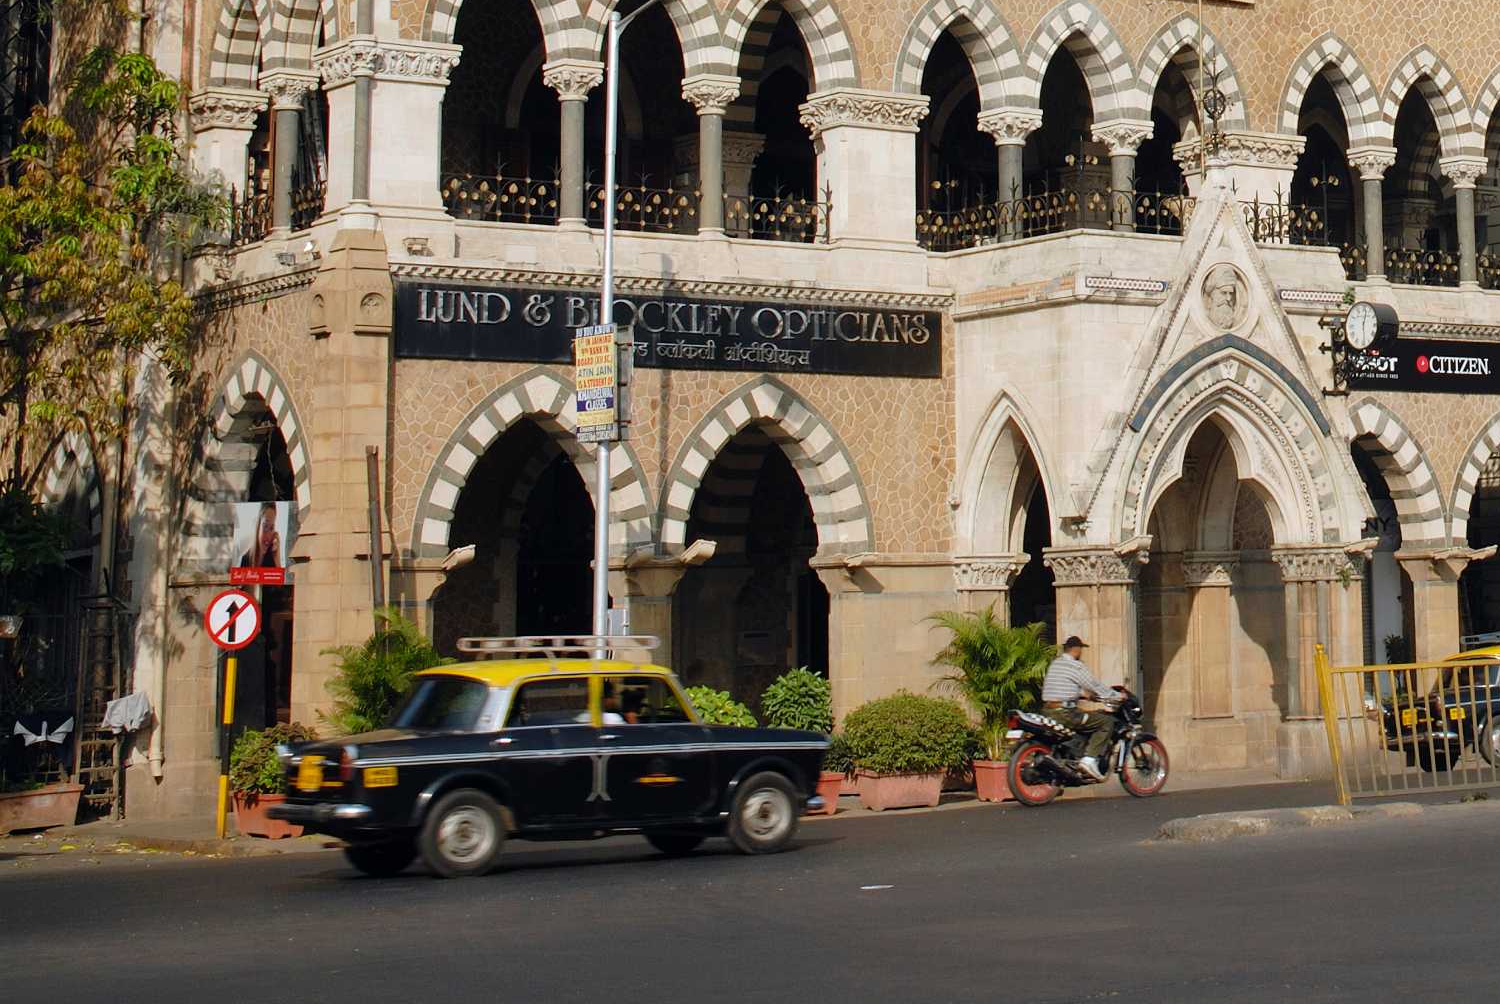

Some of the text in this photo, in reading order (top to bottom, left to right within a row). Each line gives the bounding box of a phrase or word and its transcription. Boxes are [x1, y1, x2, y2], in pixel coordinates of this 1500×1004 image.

[417, 289, 511, 324] LUND
[522, 294, 554, 327] &
[751, 307, 930, 345] OPTICIANS
